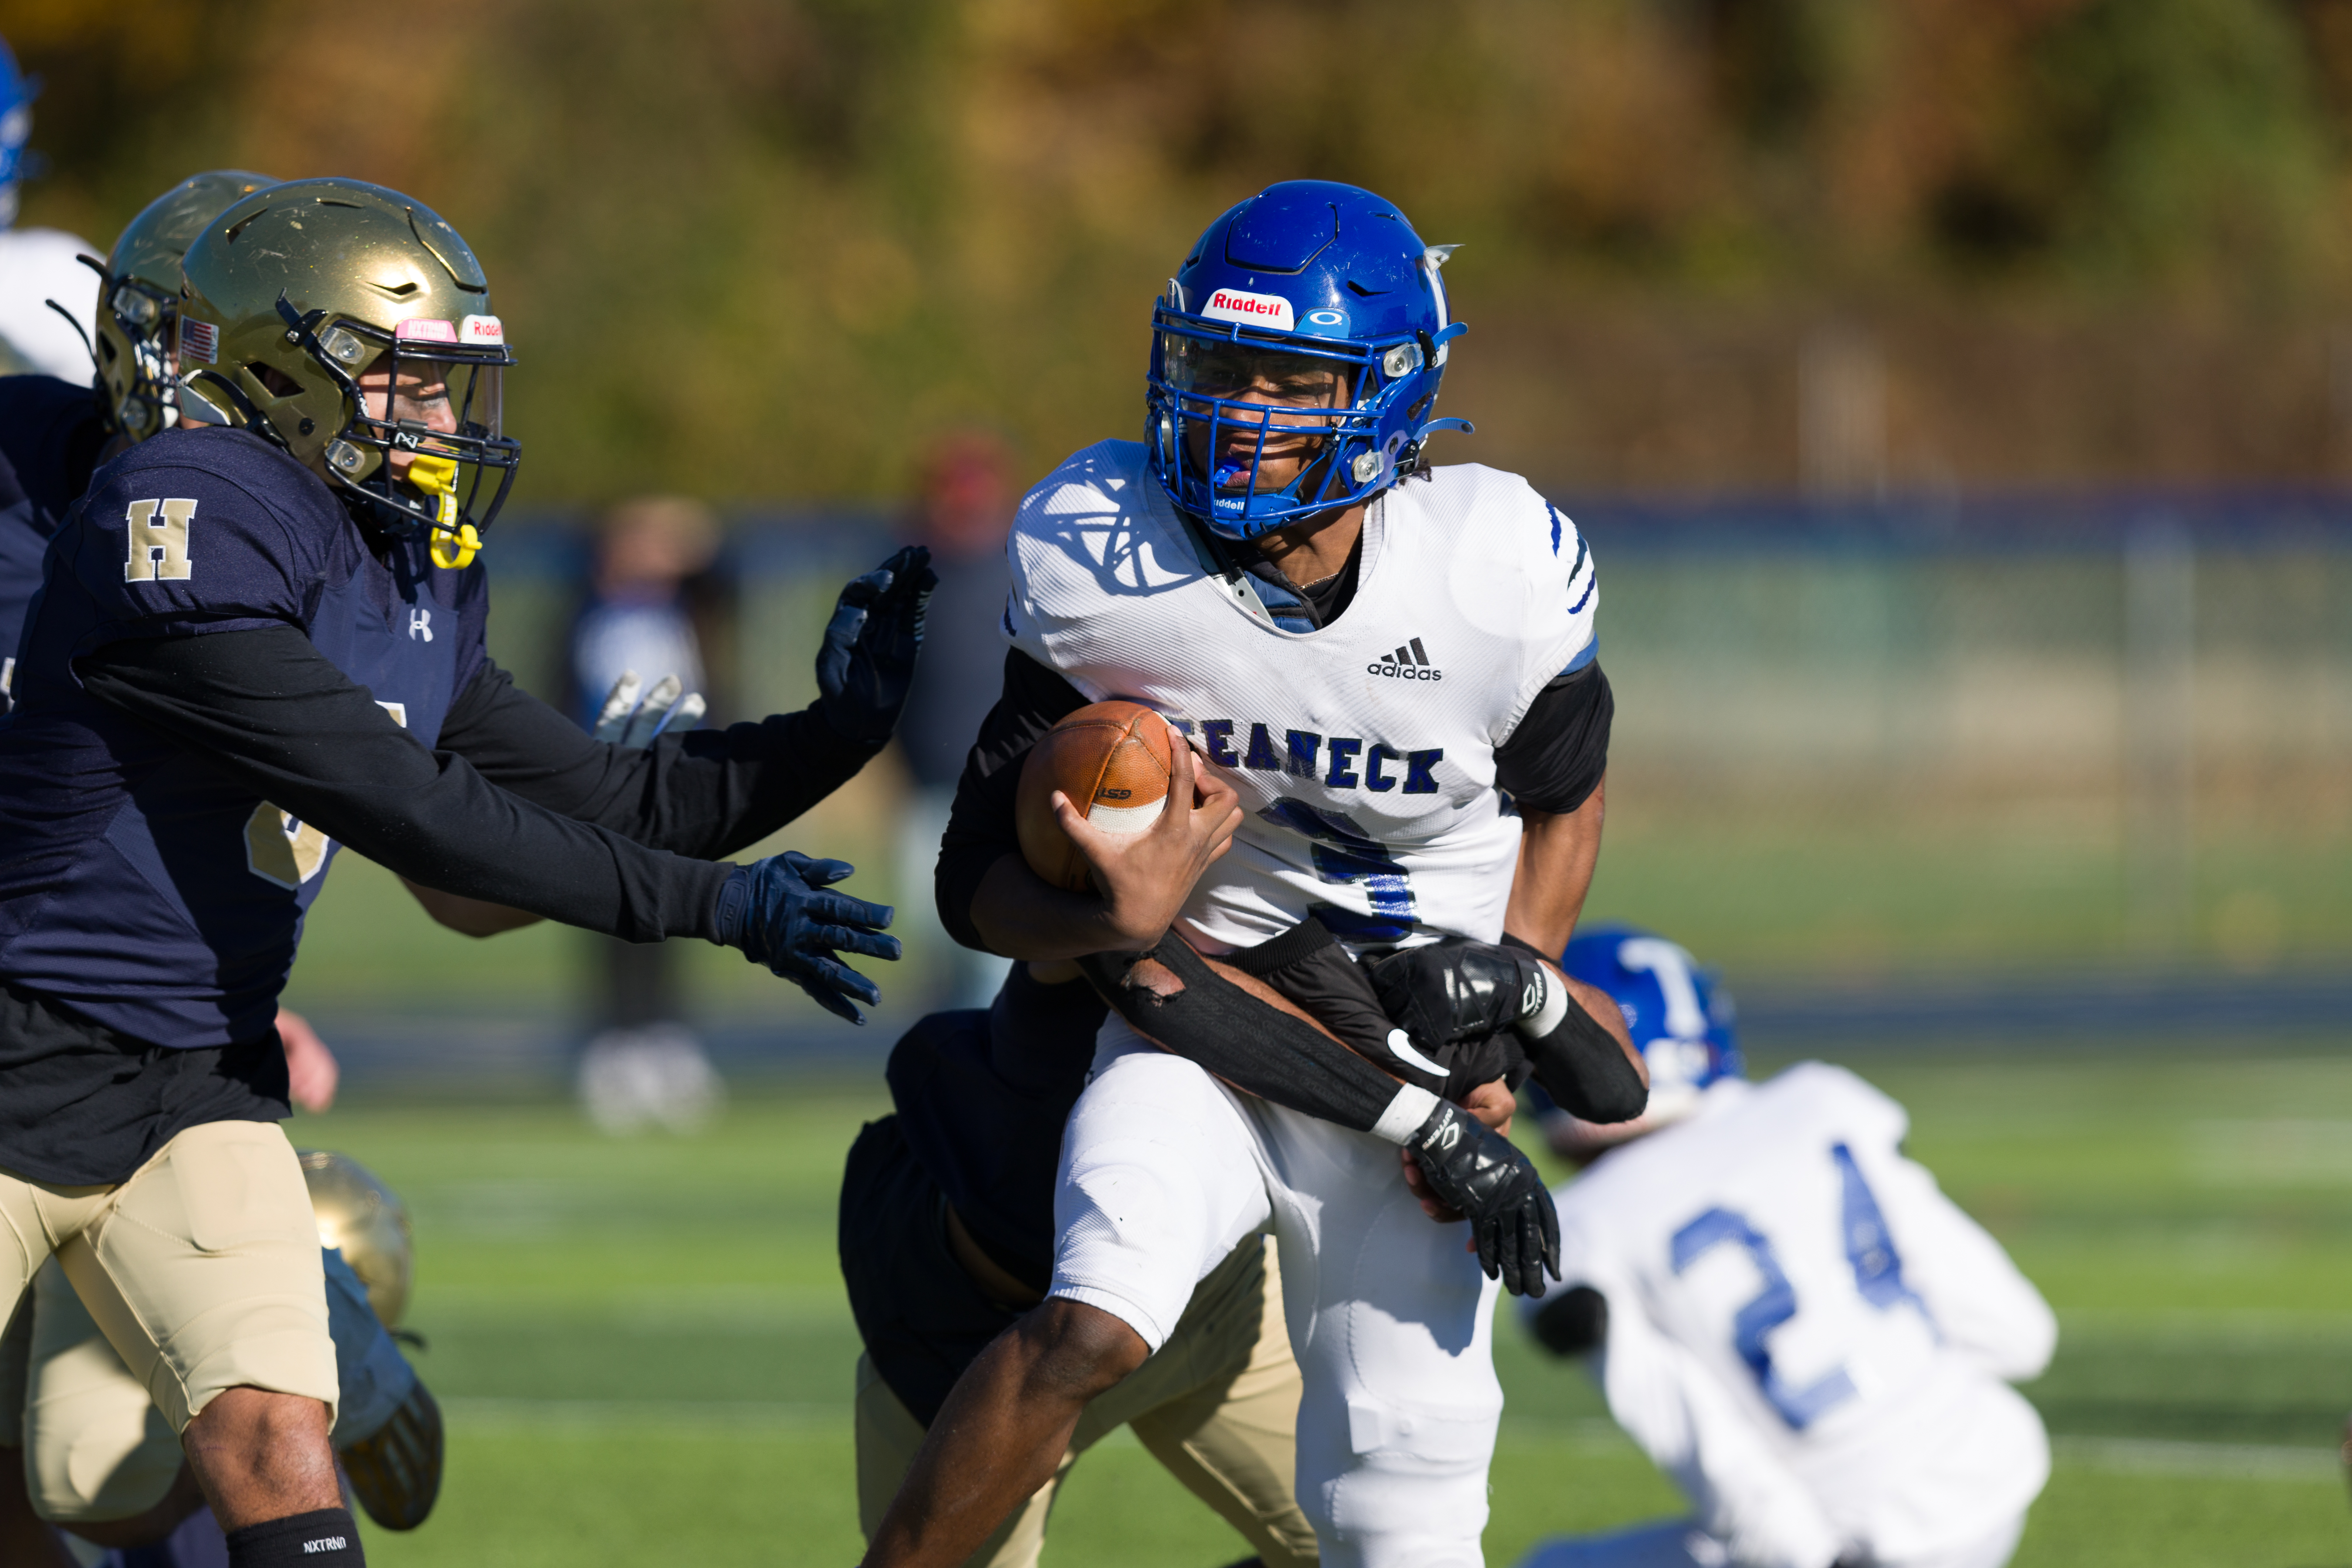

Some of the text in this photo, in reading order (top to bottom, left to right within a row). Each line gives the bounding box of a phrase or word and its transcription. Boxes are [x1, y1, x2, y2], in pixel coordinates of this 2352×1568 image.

[1213, 292, 1282, 316] Riddell
[407, 320, 448, 339] NXTRND
[1214, 498, 1246, 510] iddell
[125, 497, 198, 583] H
[1367, 662, 1442, 681] adidas
[1421, 1107, 1454, 1151] CUTTERS
[303, 1536, 347, 1553] NXTRND
